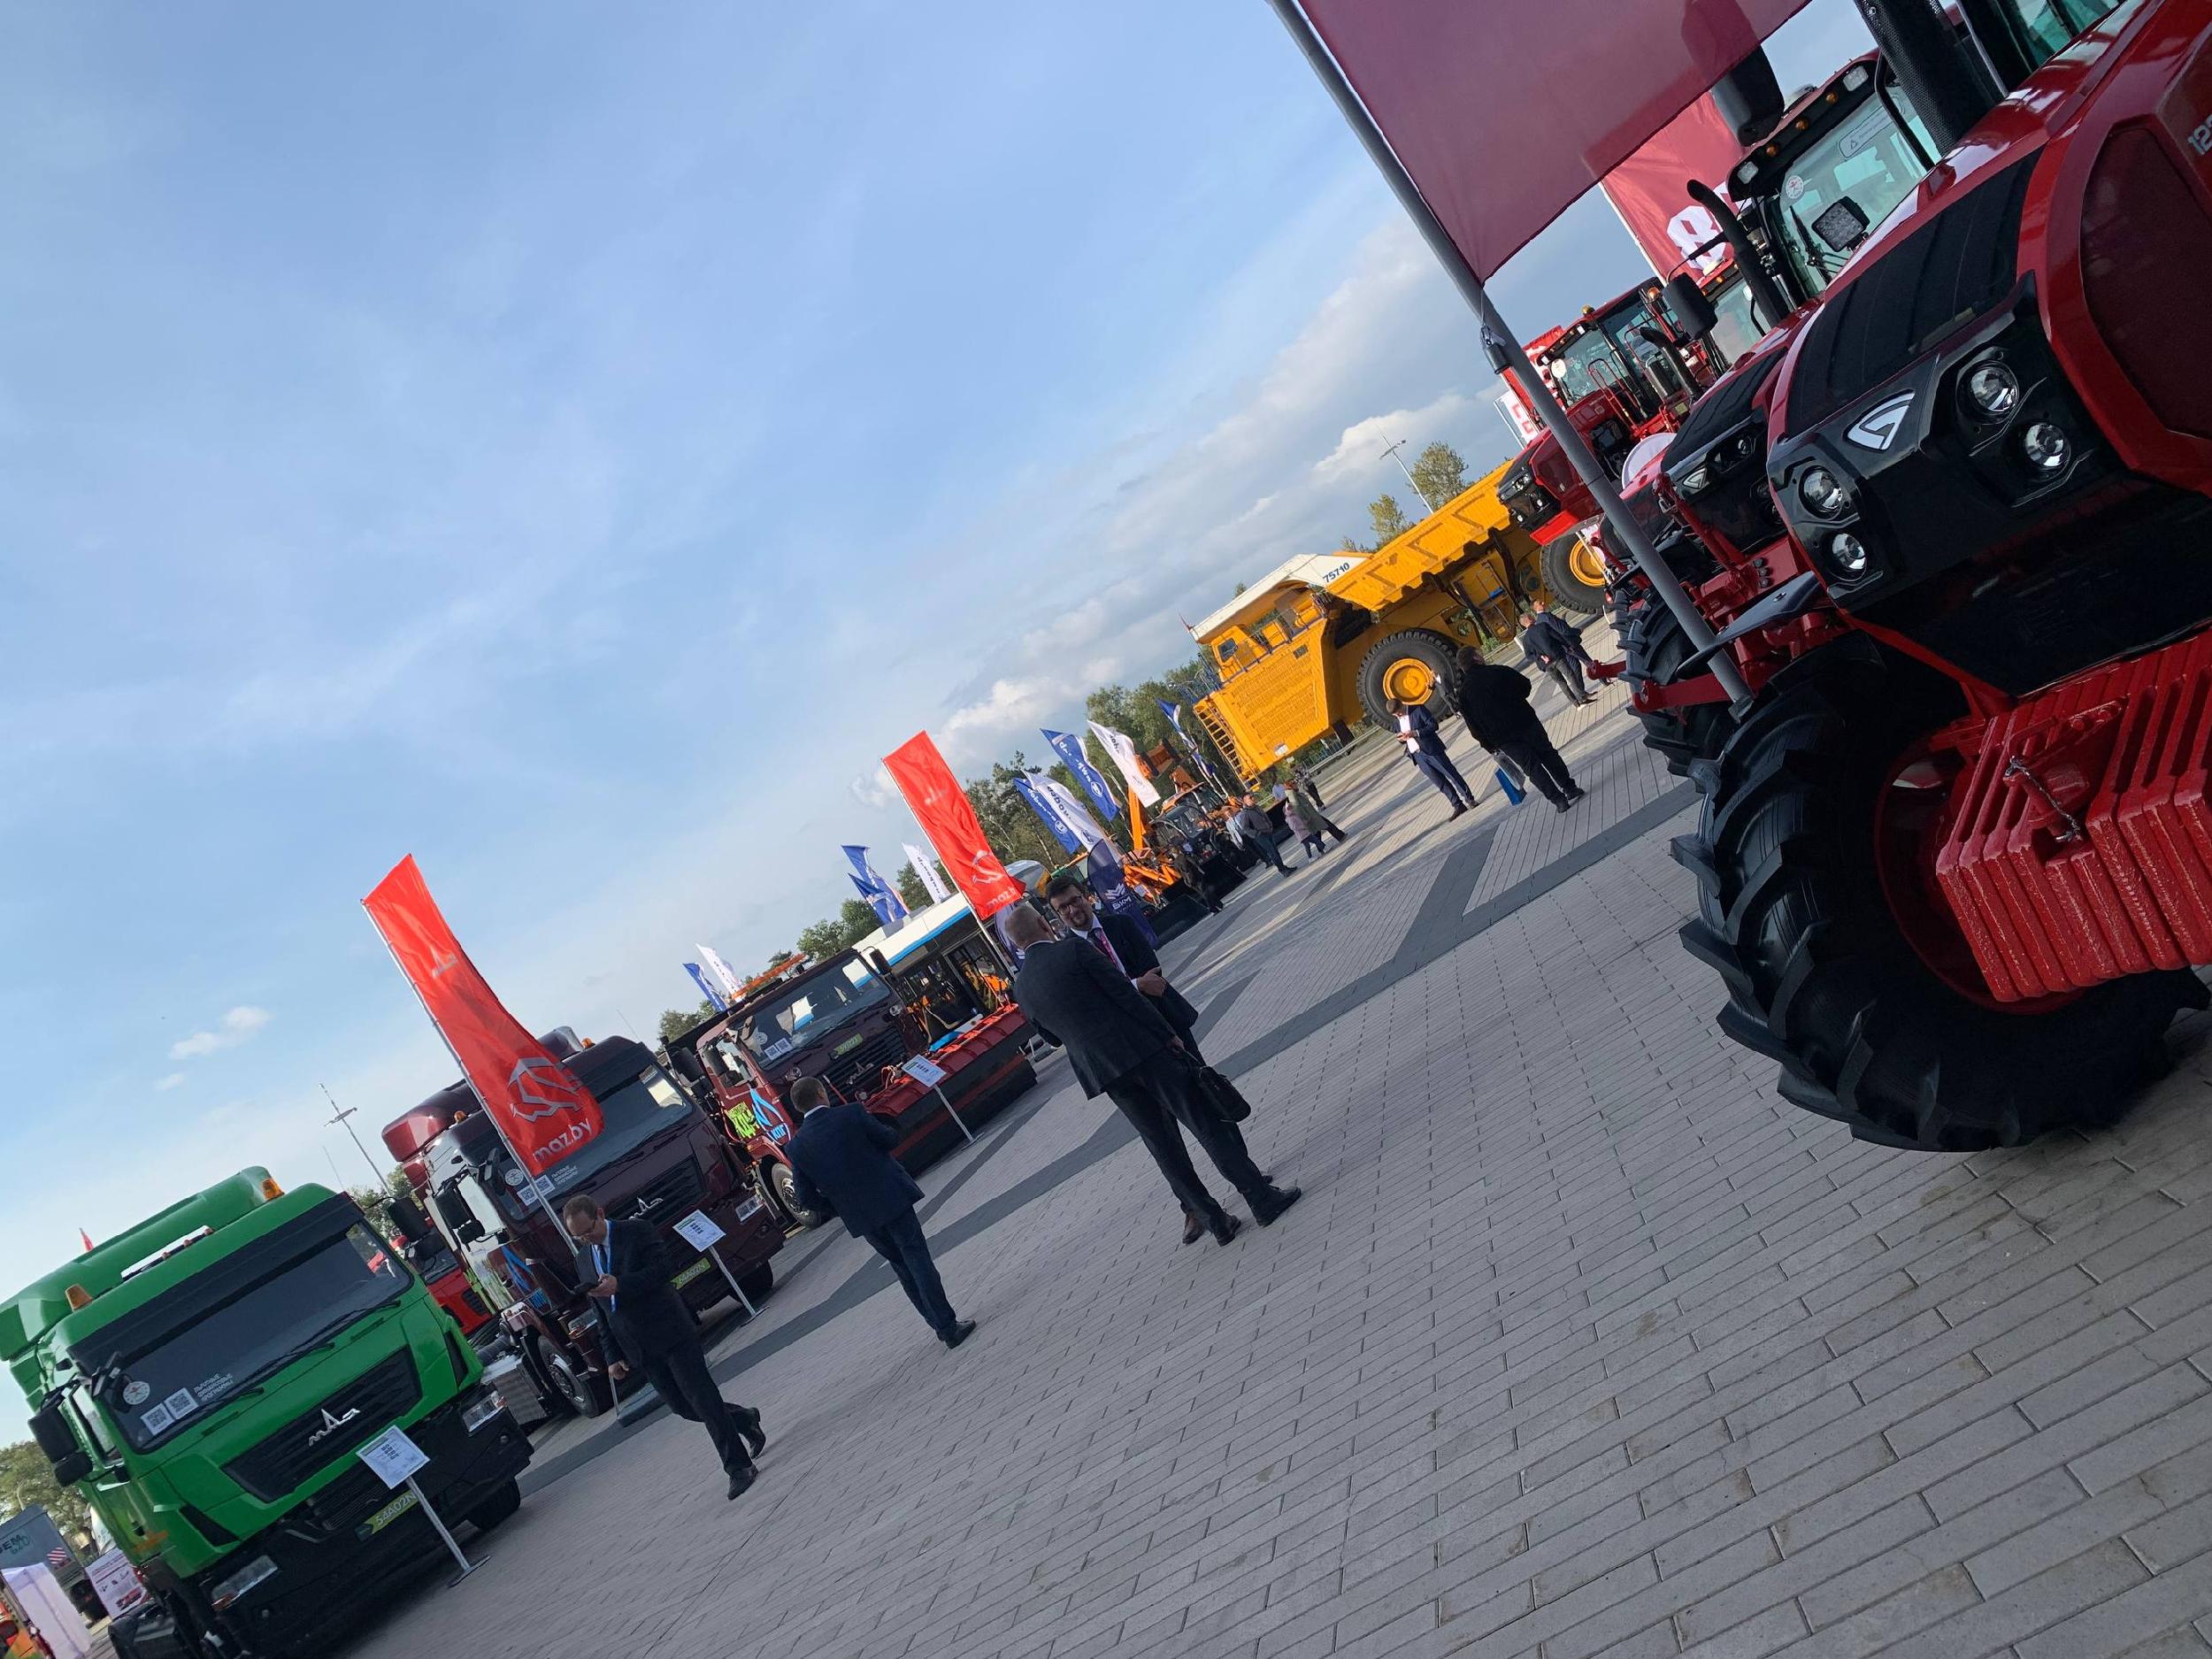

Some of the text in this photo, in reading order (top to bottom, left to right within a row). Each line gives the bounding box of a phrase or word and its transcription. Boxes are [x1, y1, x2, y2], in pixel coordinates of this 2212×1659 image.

[2187, 113, 2212, 156] 12
[1323, 562, 1350, 583] 75710
[533, 1117, 594, 1164] maz.by
